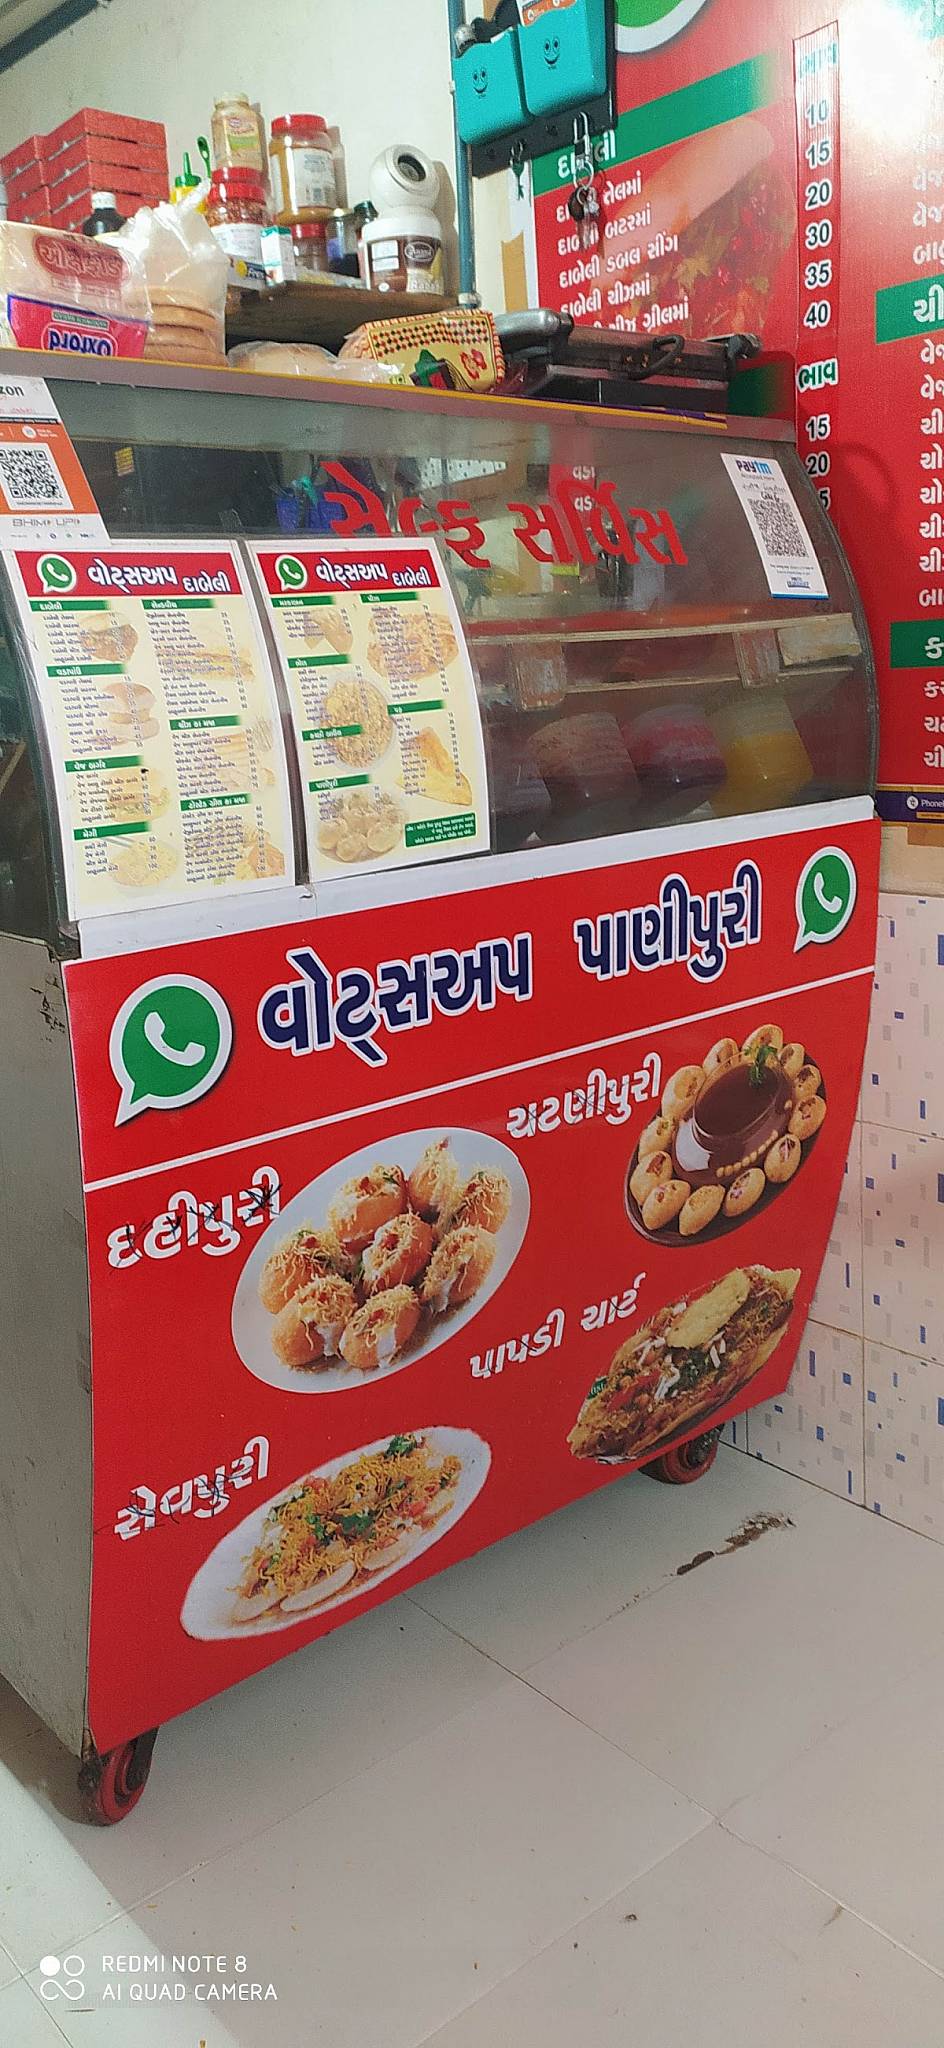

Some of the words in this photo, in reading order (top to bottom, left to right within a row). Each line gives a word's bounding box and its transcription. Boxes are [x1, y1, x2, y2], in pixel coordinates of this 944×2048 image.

[807, 100, 828, 127] 10
[806, 140, 831, 167] 15
[603, 170, 642, 206] તેલમાં
[805, 180, 831, 209] 20
[604, 203, 651, 240] બટરમાં
[805, 220, 832, 248] 30
[559, 254, 600, 289] દાબેલી
[606, 246, 641, 273] ડબલ
[648, 232, 679, 260] સીંગ
[805, 260, 831, 288] 35
[608, 272, 651, 304] ચીઝમાં
[642, 295, 690, 332] ગ્રીલમાં
[804, 301, 830, 329] 40
[799, 359, 837, 390] ભાવ
[806, 416, 830, 440] 15
[806, 456, 829, 476] 20
[87, 557, 178, 595] વોટ્સઅપ
[182, 570, 231, 594] દાબેલી
[315, 556, 389, 590] વોટ્સઅપ
[391, 566, 431, 588] દાબેલી
[258, 946, 533, 1068] વોટ્સઅપ
[572, 858, 763, 984] પાણીપુરી
[506, 1051, 662, 1139] ચટણીપુરી
[106, 1165, 281, 1269] દહીપુરી
[470, 1307, 566, 1379] પાપડી
[580, 1271, 647, 1332] ચાર્ટ
[113, 1435, 270, 1541] સેવપુરી
